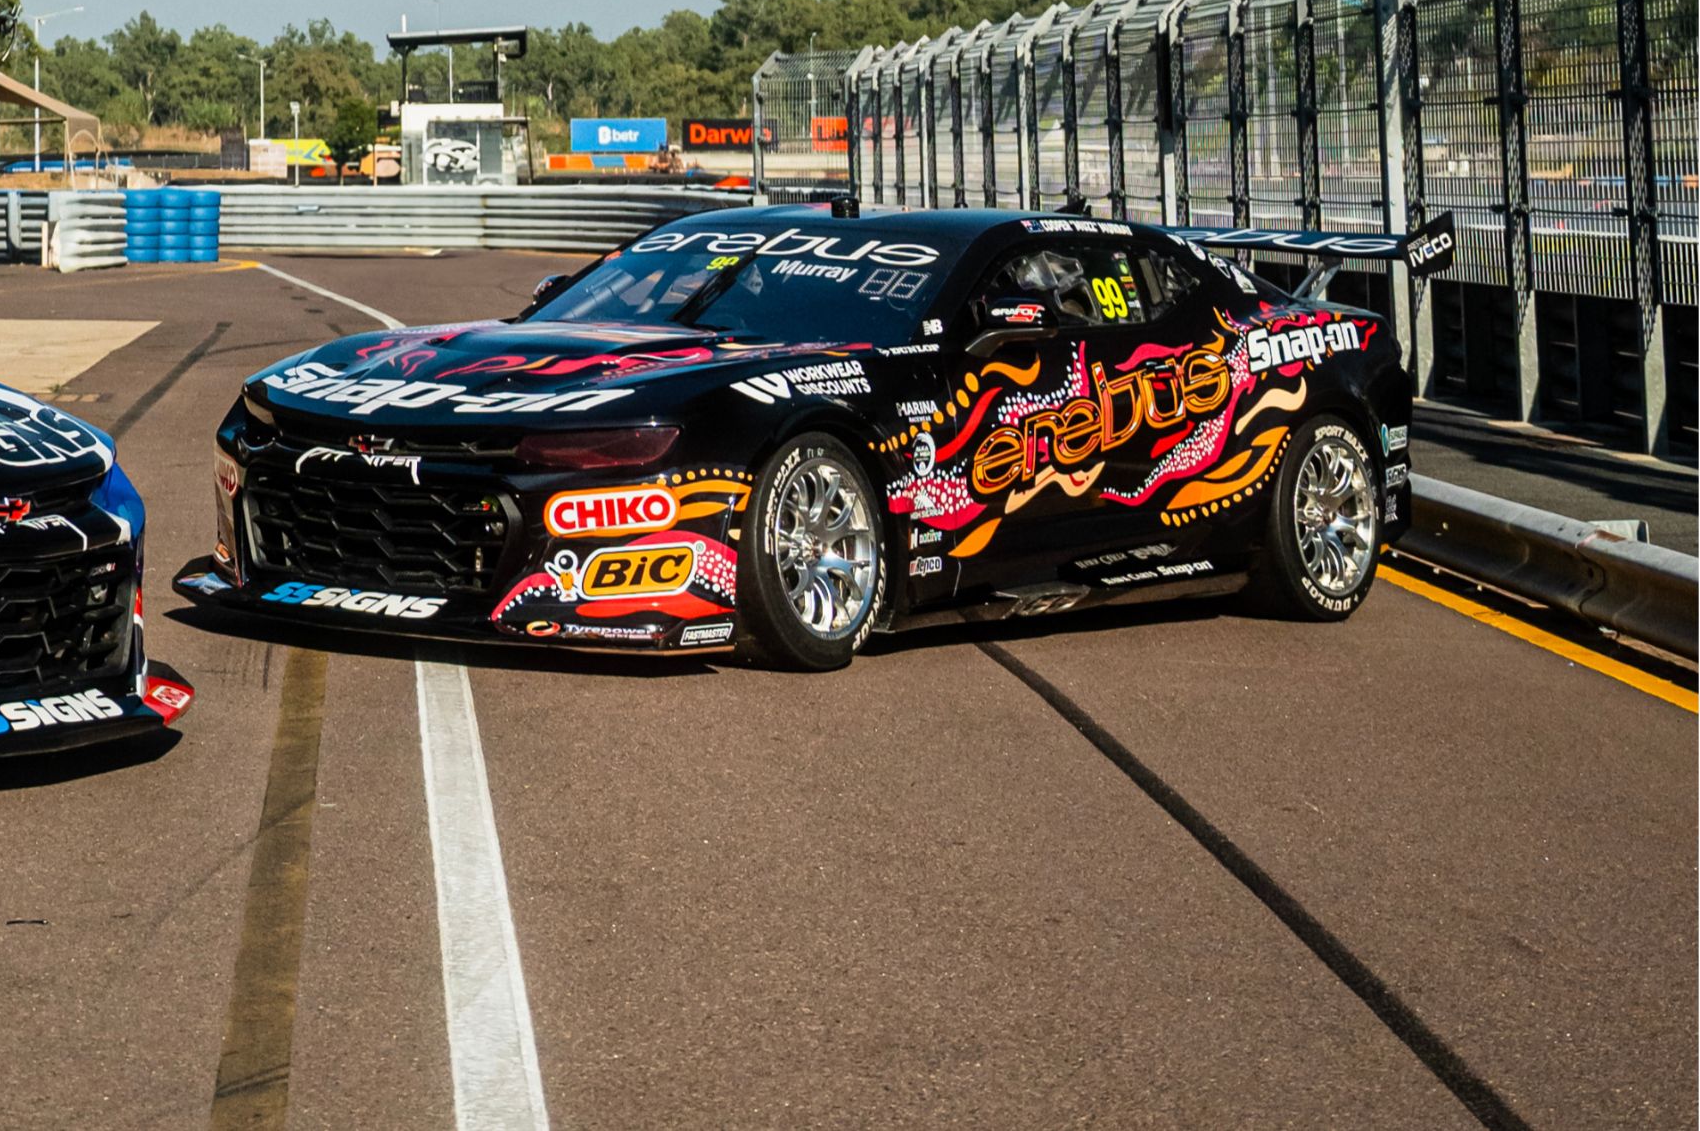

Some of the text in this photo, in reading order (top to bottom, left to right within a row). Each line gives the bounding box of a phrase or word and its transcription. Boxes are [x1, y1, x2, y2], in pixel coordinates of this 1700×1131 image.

[612, 129, 639, 142] betr
[631, 228, 940, 266] erebus
[1409, 232, 1452, 267] IVECO
[771, 259, 859, 283] Murray
[1092, 277, 1128, 319] 99
[889, 343, 940, 356] DUNLOP
[1247, 318, 1361, 373] Snap-on
[785, 360, 863, 385] WORKWEAR
[796, 373, 871, 396] DISCOUNTS
[263, 362, 636, 415] Snap-on
[896, 400, 939, 417] MARINA
[971, 348, 1234, 495] erebus
[1314, 425, 1345, 442] SPORT
[554, 494, 670, 529] CHIKO
[1157, 558, 1215, 577] Snap-on
[1301, 575, 1352, 612] DUNLOP
[564, 624, 656, 637] Tyrepower
[683, 628, 730, 642] FASTMASTER
